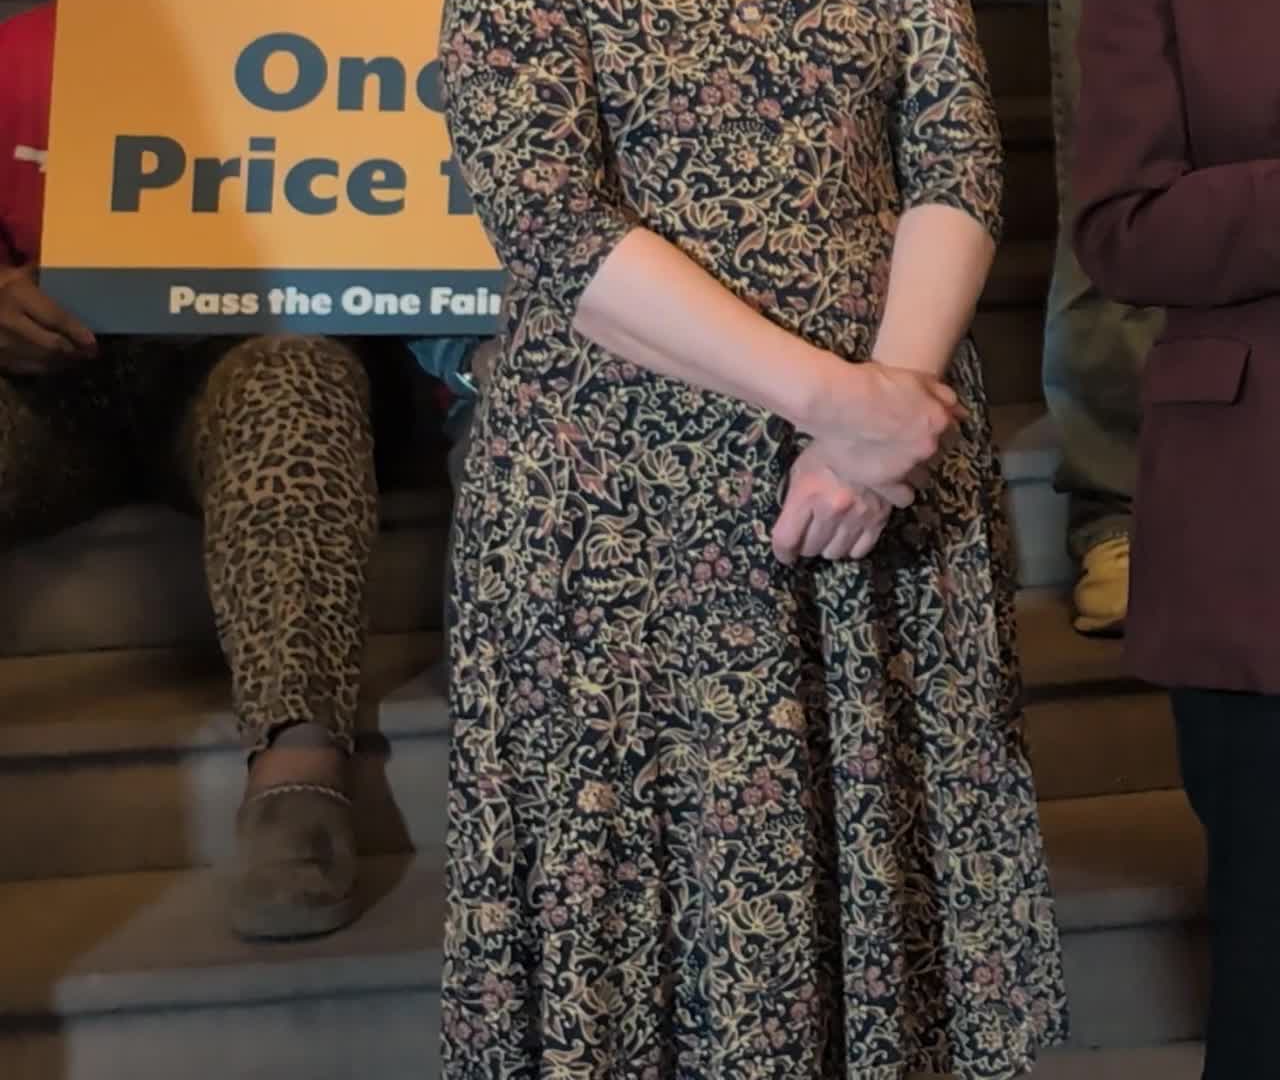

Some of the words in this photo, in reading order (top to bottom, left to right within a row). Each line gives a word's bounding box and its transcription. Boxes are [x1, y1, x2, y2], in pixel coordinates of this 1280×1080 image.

[109, 134, 408, 216] Price
[168, 286, 260, 316] Pass
[269, 286, 333, 316] the
[340, 286, 421, 316] One
